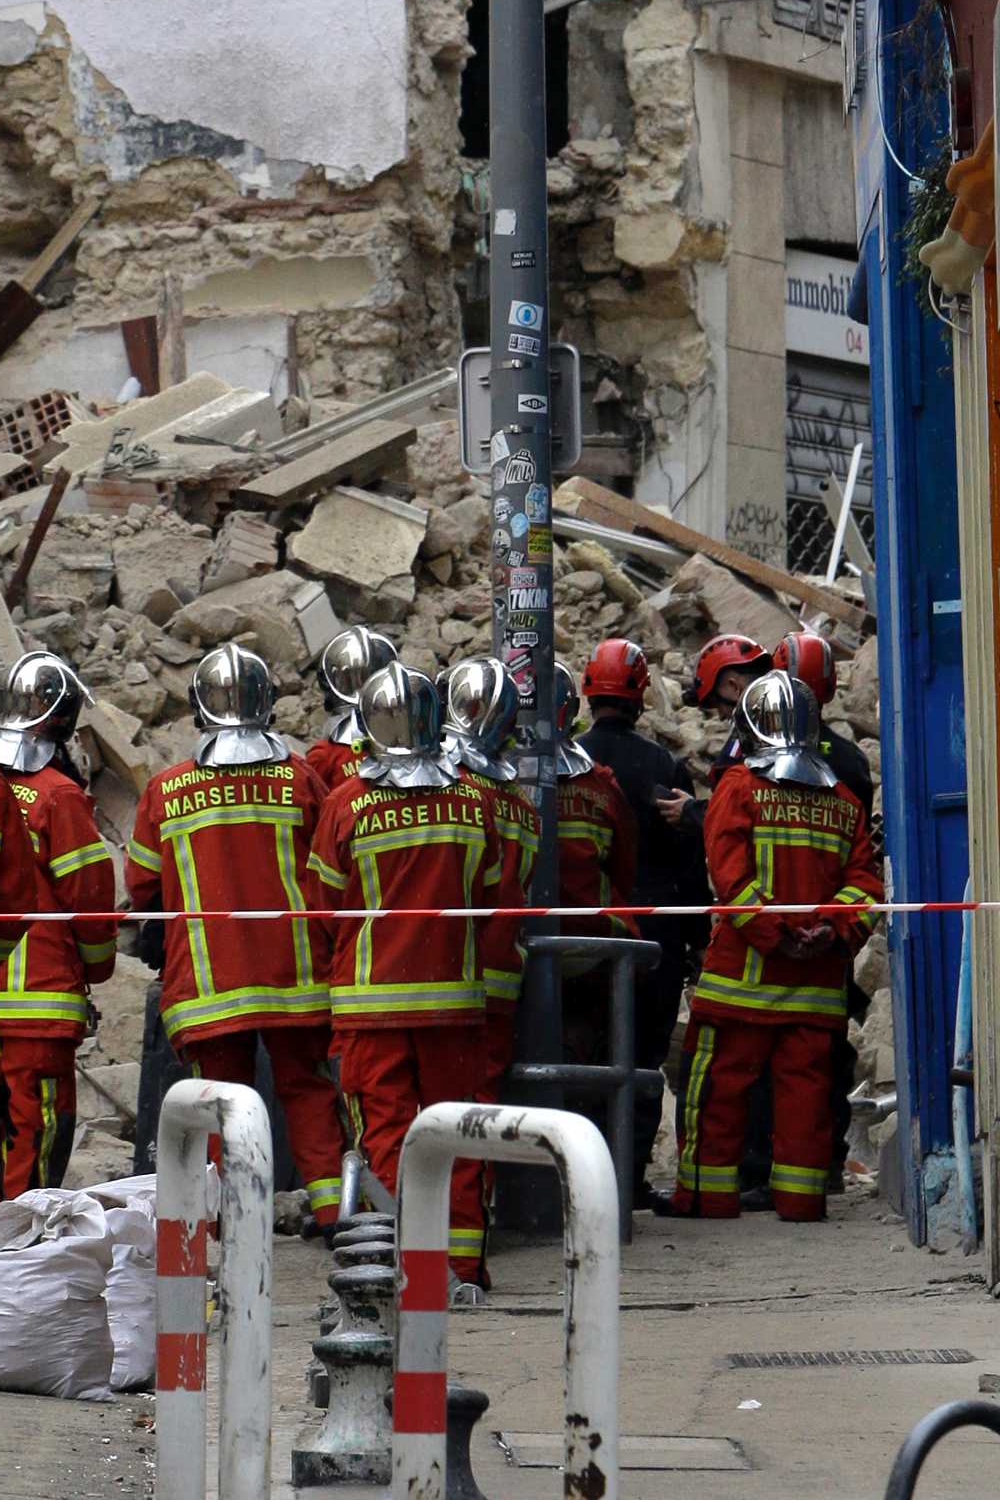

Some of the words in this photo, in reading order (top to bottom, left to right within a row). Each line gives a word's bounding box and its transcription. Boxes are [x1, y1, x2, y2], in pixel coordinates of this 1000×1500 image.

[846, 327, 863, 354] 04
[161, 766, 215, 795] MARINS
[164, 784, 294, 818] MARSEILLE
[350, 788, 408, 814] MARINS
[355, 803, 484, 836] MARSEILLE
